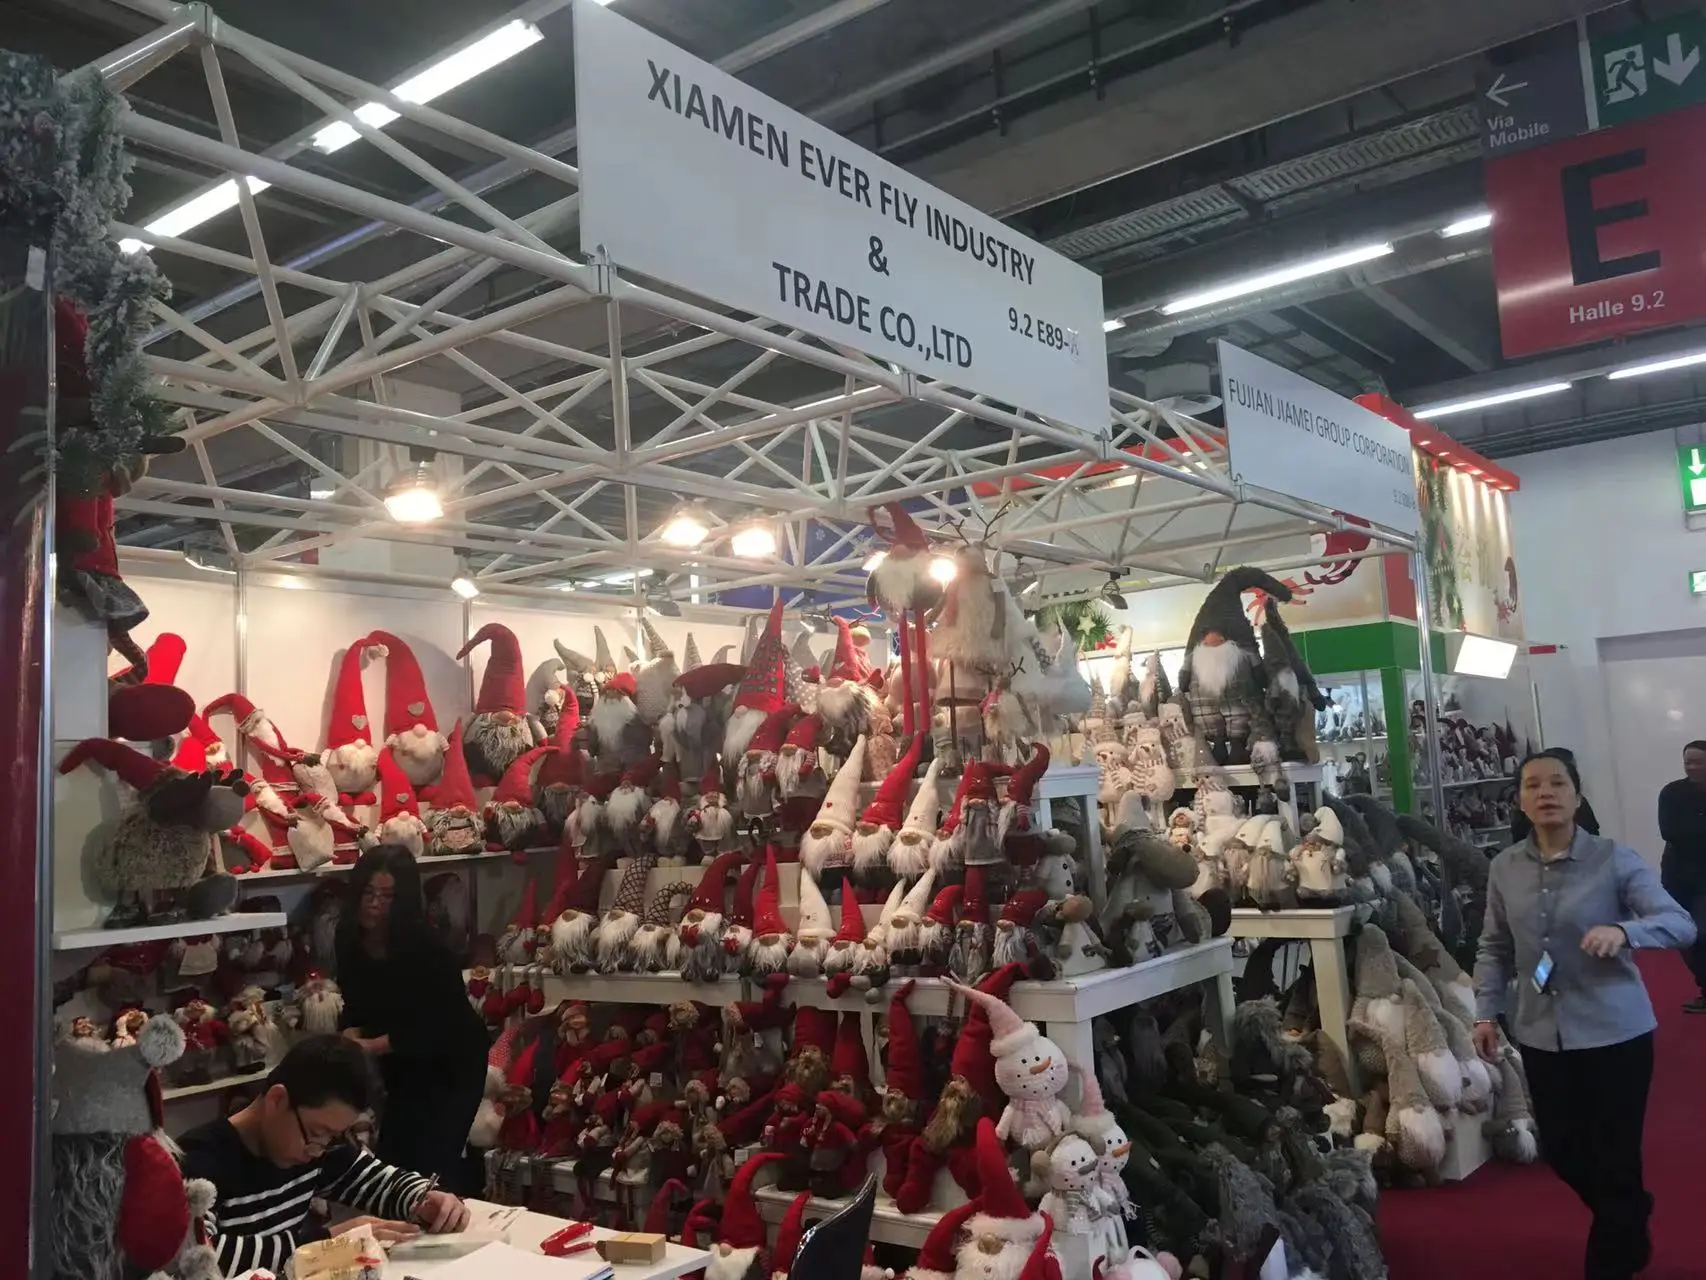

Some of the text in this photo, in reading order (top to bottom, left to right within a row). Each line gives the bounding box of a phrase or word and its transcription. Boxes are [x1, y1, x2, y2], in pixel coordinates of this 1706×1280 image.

[1487, 115, 1514, 132] Via
[1489, 120, 1550, 148] Mobile
[646, 58, 1036, 286] XIAMEN EVER FLY INDUSTRY
[1560, 147, 1661, 286] E
[868, 235, 890, 276] &
[772, 260, 973, 370] TRADE CO.,LTD
[1008, 307, 1033, 339] 9.2
[1569, 290, 1666, 324] Halle 9.2
[1228, 378, 1411, 476] FUJIAN JIAMEI GROUP CORPORATION
